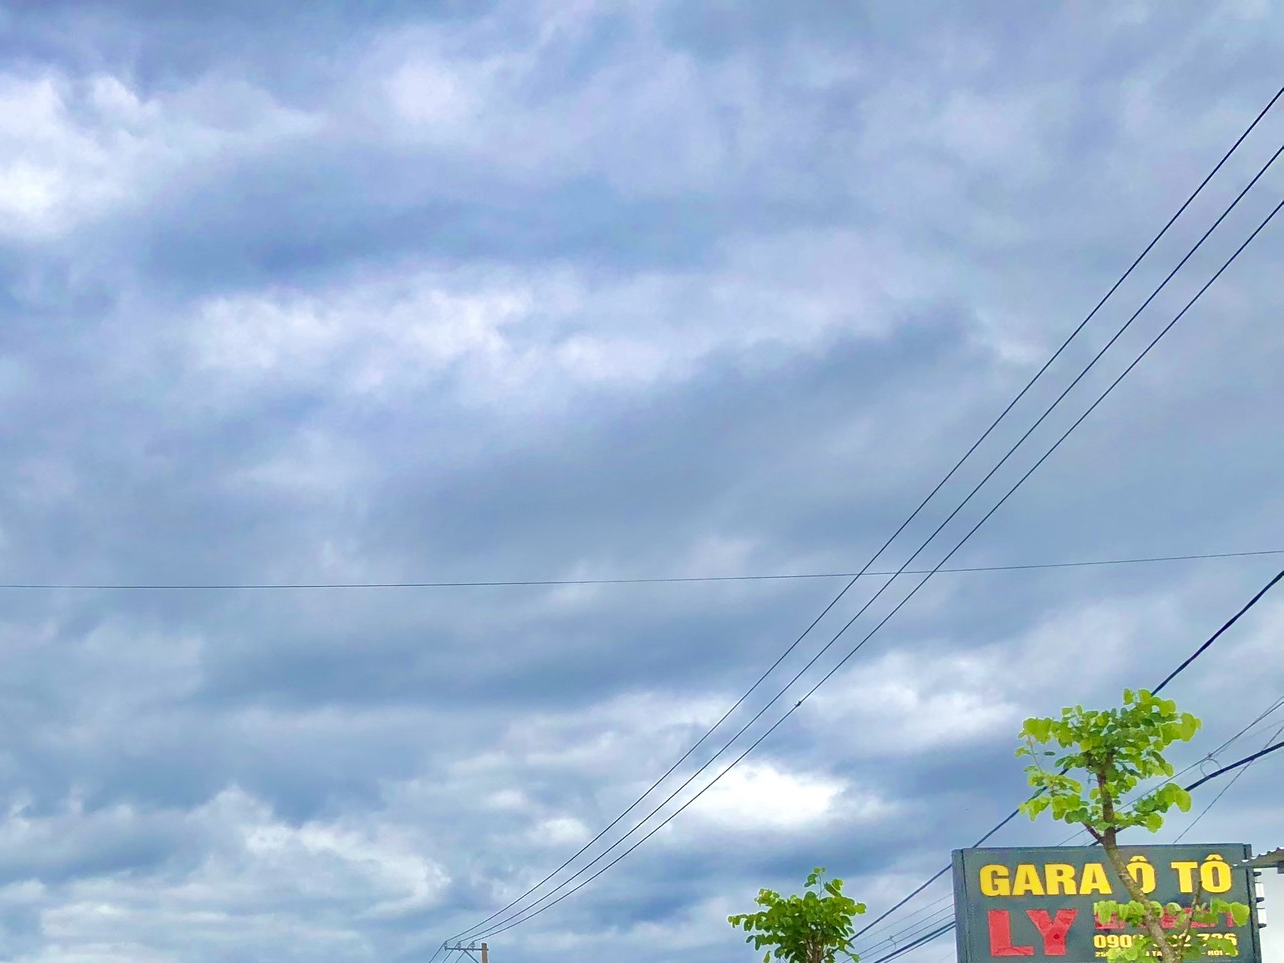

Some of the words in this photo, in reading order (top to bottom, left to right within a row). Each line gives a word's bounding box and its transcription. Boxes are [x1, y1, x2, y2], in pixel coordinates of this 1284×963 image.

[979, 862, 1112, 897] GARA
[1126, 854, 1156, 894] Ô
[1170, 853, 1233, 893] TÔ
[987, 908, 1078, 957] LY
